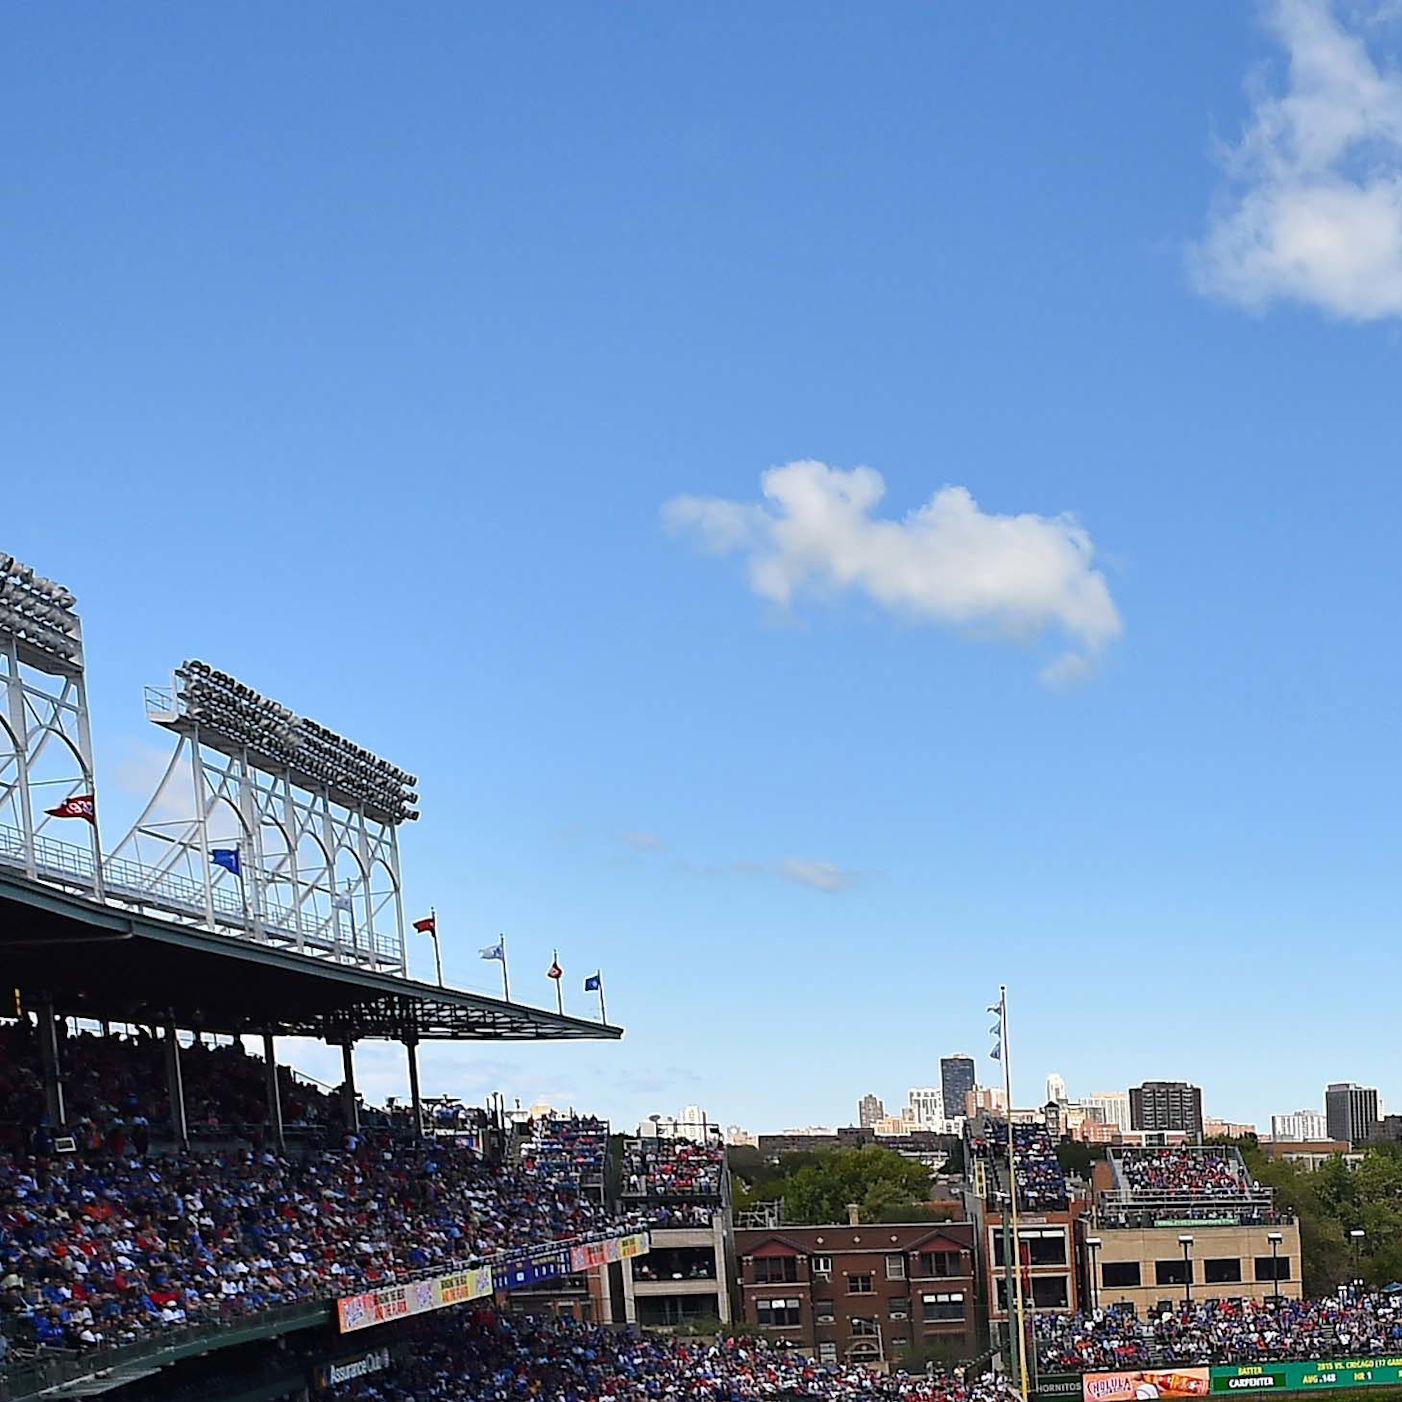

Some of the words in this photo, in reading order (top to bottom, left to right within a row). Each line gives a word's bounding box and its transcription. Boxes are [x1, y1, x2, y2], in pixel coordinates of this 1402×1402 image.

[1238, 1366, 1262, 1375] BATTER
[1037, 1382, 1082, 1393] HORNITOS
[1229, 1376, 1274, 1389] CARPENTER
